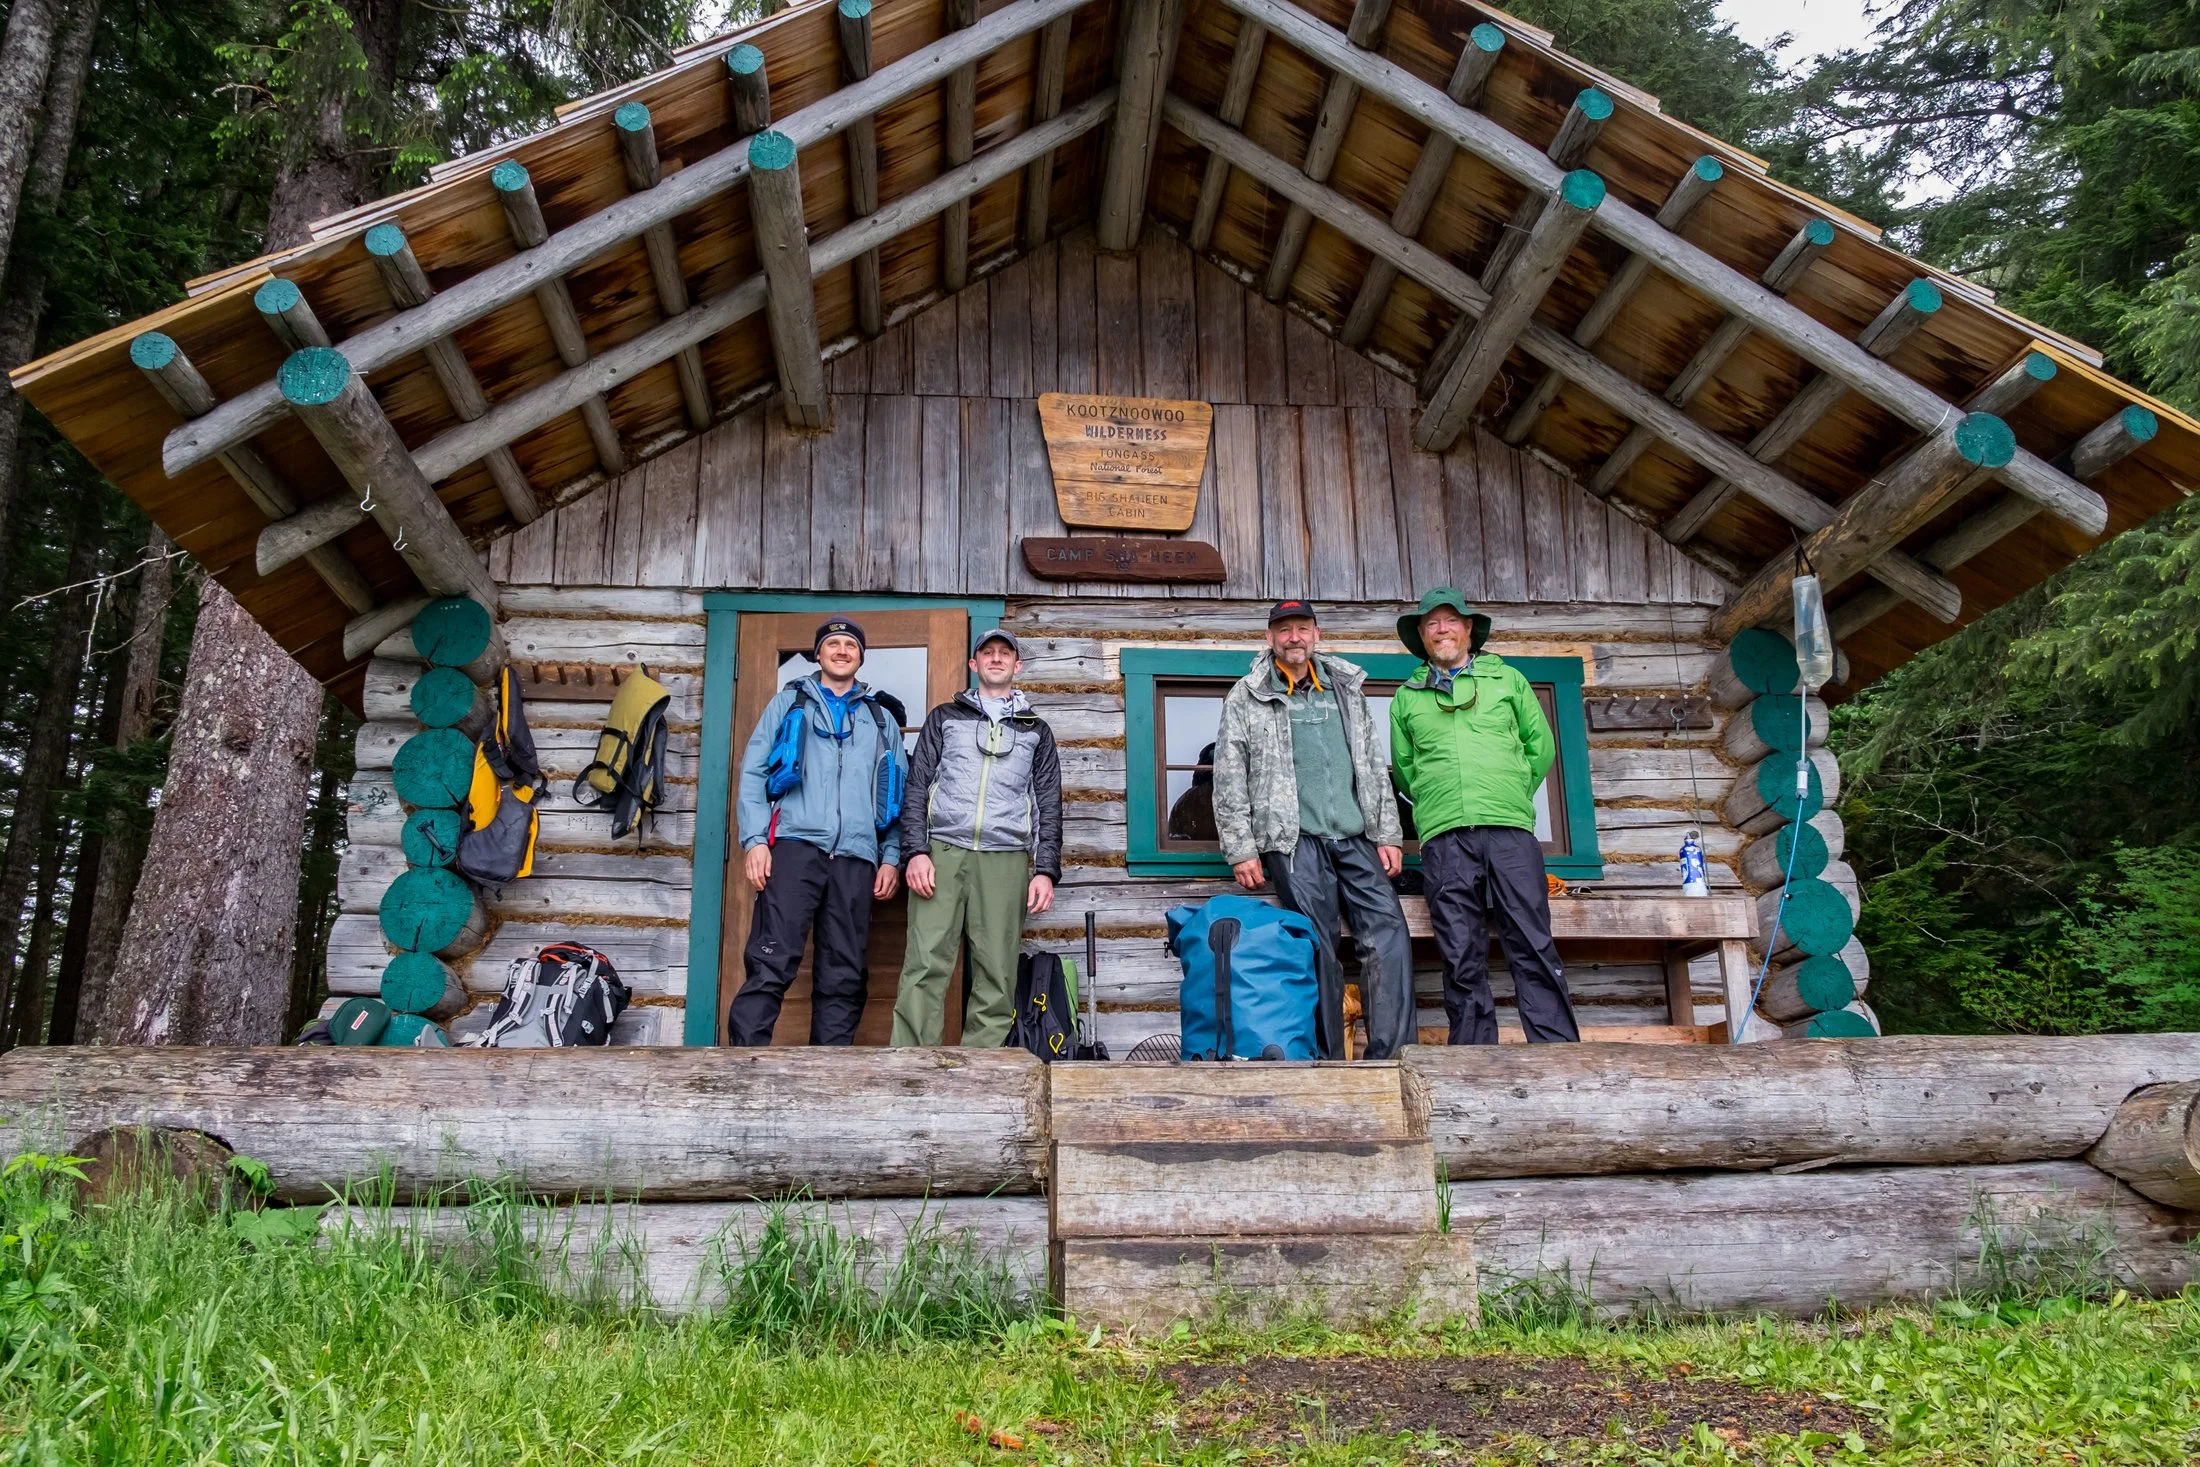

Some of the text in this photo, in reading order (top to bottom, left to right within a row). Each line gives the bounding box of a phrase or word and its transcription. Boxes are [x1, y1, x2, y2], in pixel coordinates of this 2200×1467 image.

[1067, 404, 1185, 423] KOOTZNOOWOO
[1085, 425, 1168, 441] WILDERNESS
[1100, 448, 1155, 461] TONGASS
[1090, 461, 1163, 474] National Forest
[1107, 506, 1145, 518] CABIN
[1047, 547, 1094, 561] CAMP
